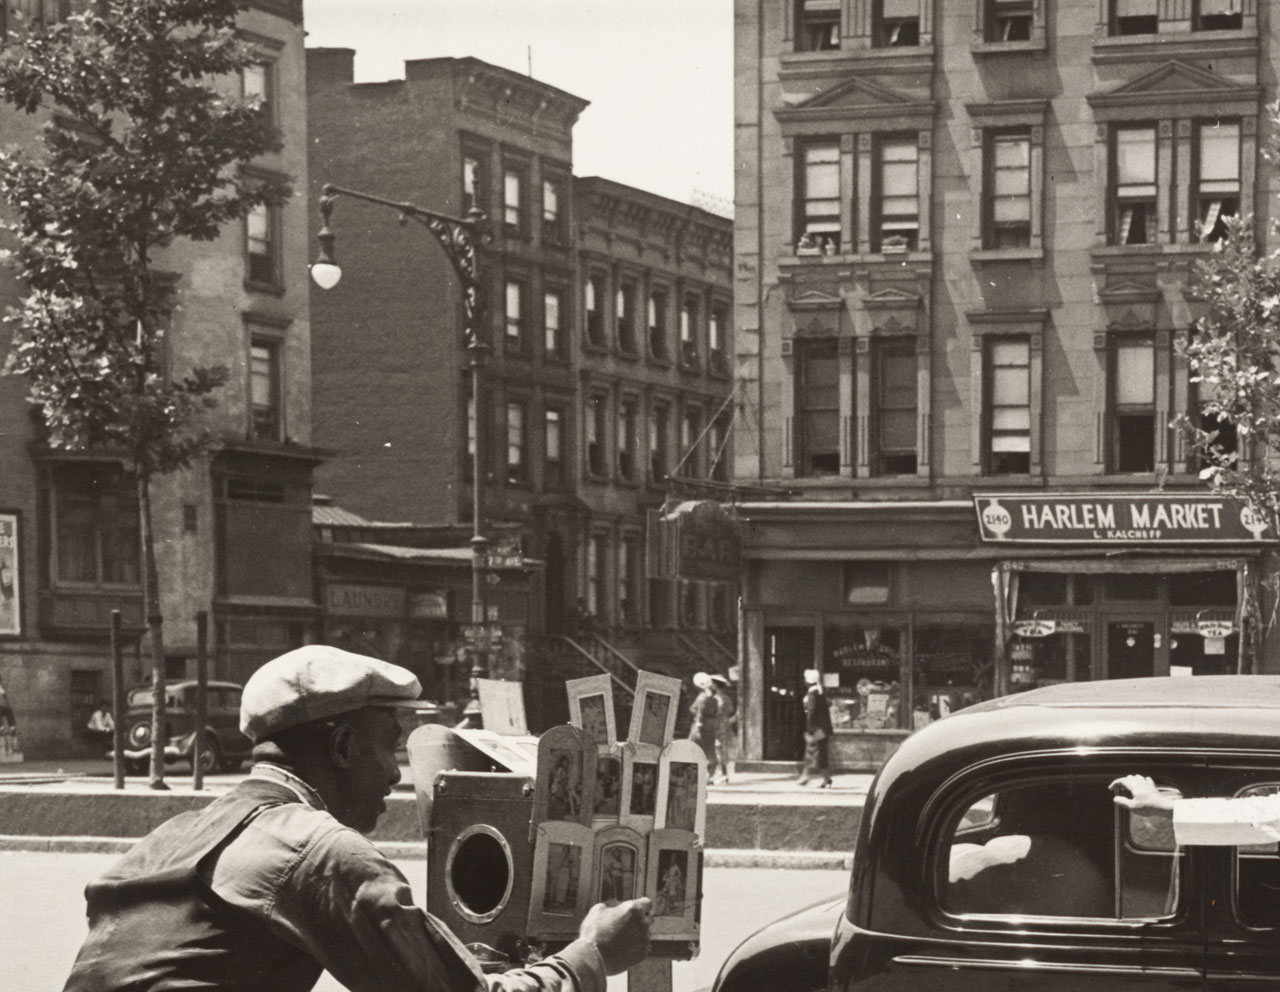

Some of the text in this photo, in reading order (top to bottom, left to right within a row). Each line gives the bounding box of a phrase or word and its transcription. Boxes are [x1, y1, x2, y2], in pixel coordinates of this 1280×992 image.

[985, 513, 1010, 526] 2140
[1021, 503, 1224, 529] HARLEM MARKET
[1243, 513, 1268, 526] 214
